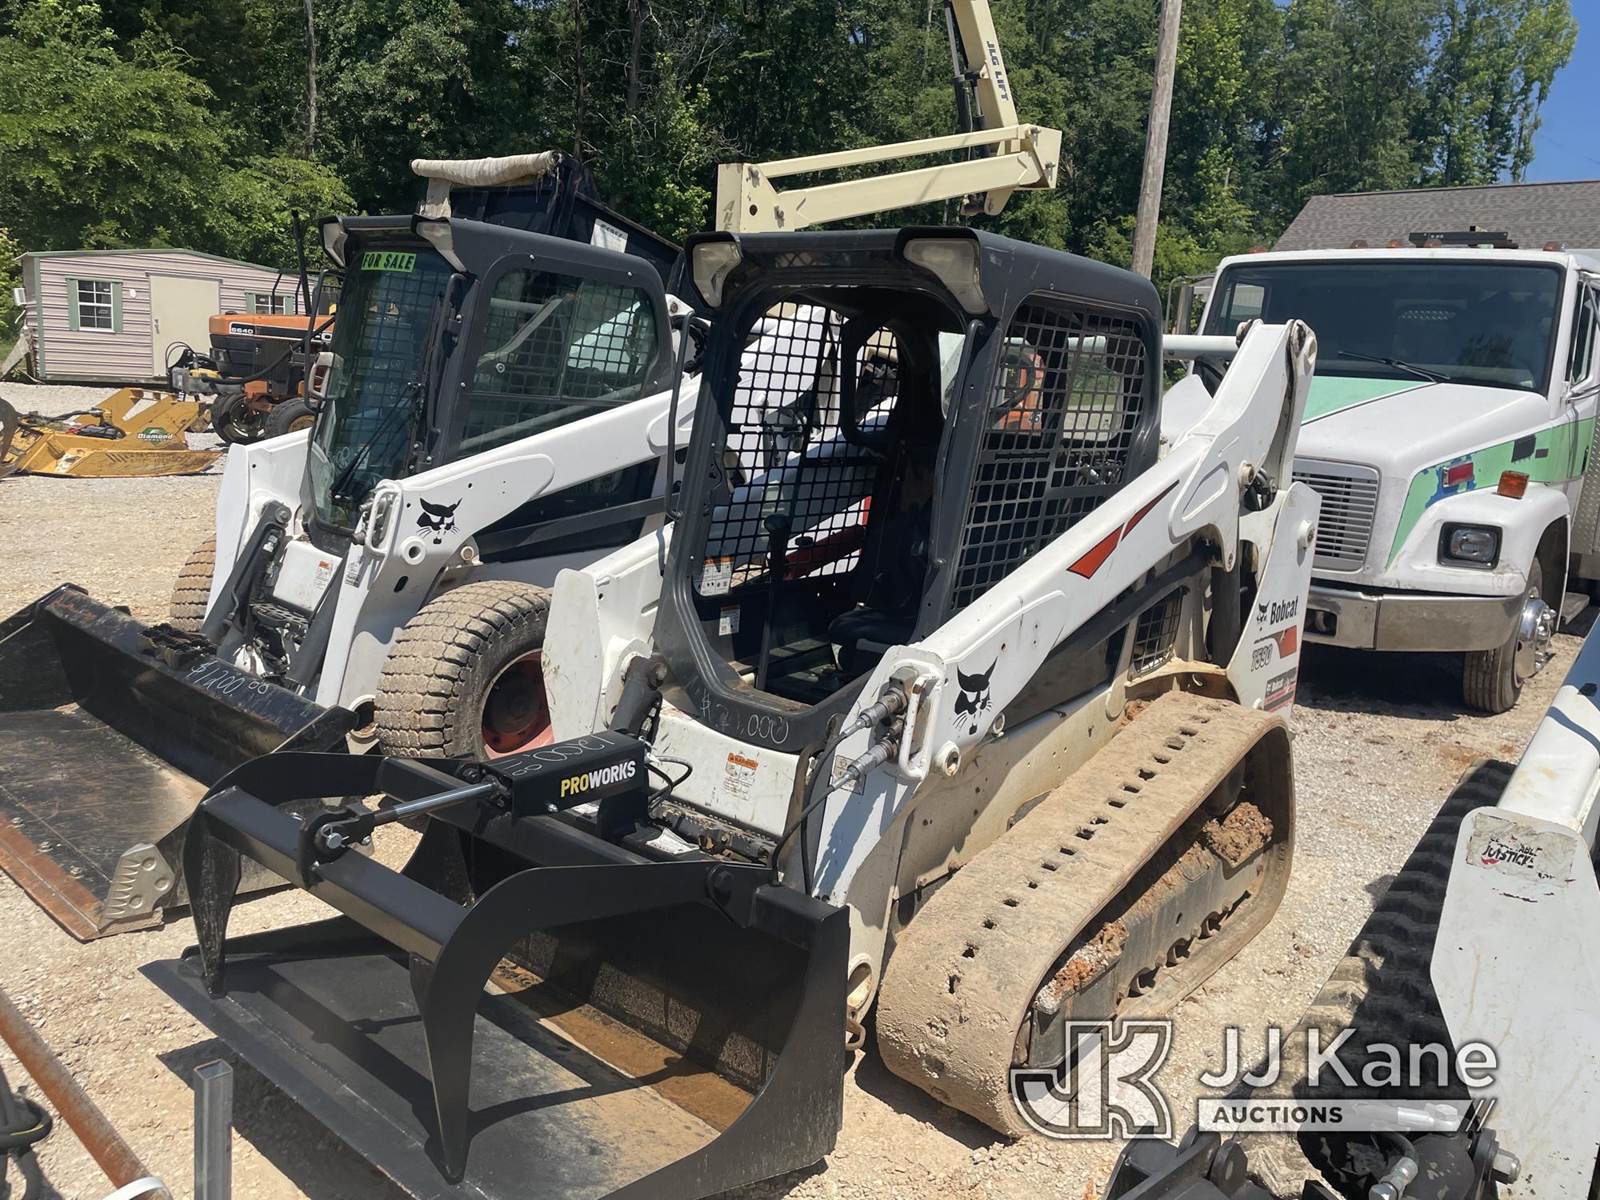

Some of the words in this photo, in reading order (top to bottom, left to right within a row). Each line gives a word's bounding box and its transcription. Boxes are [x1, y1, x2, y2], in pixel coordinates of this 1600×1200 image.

[986, 40, 1000, 66] JLG
[994, 71, 1009, 101] LIFT
[362, 253, 382, 268] FOR
[383, 253, 415, 270] SALE
[1269, 595, 1299, 626] Bobcat
[560, 760, 637, 798] PROWORKS
